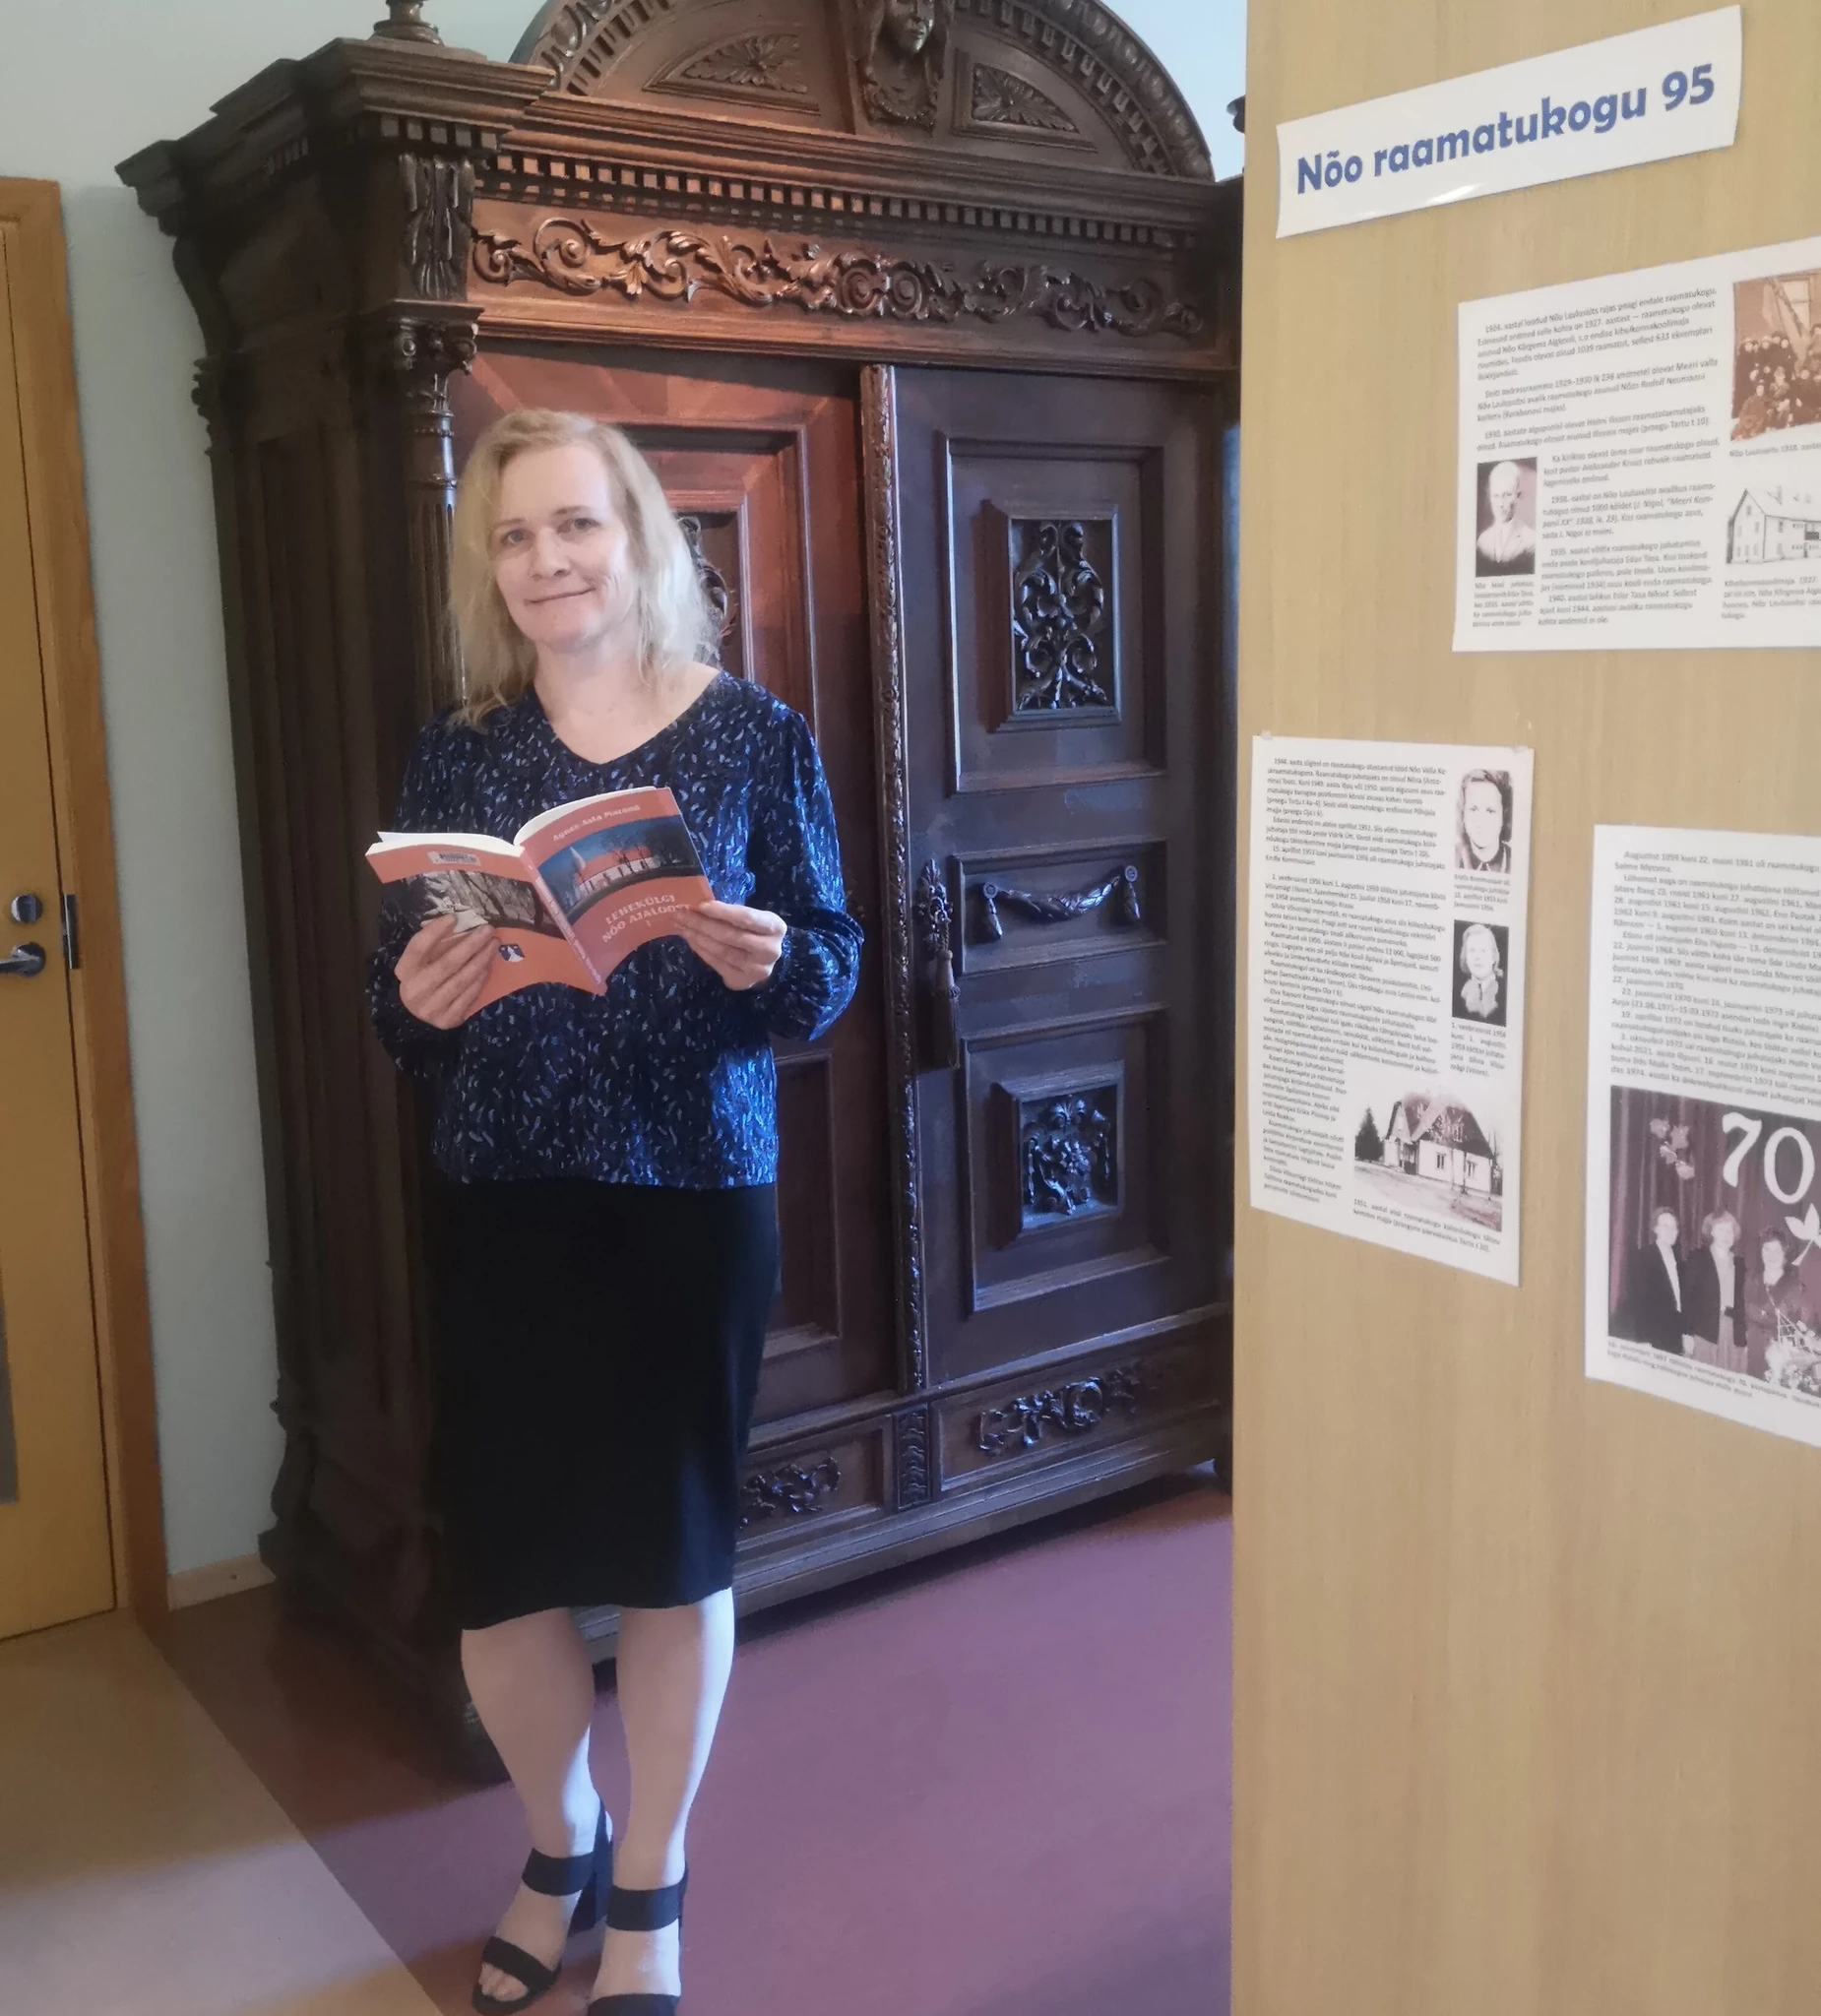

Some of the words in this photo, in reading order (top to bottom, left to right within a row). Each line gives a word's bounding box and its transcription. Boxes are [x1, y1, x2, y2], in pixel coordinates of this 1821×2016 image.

[1297, 152, 1362, 194] Nõo
[1374, 88, 1648, 177] raamatukogu
[1662, 63, 1716, 111] 95
[1548, 312, 1563, 321] Nõo
[1721, 1110, 1815, 1206] 70
